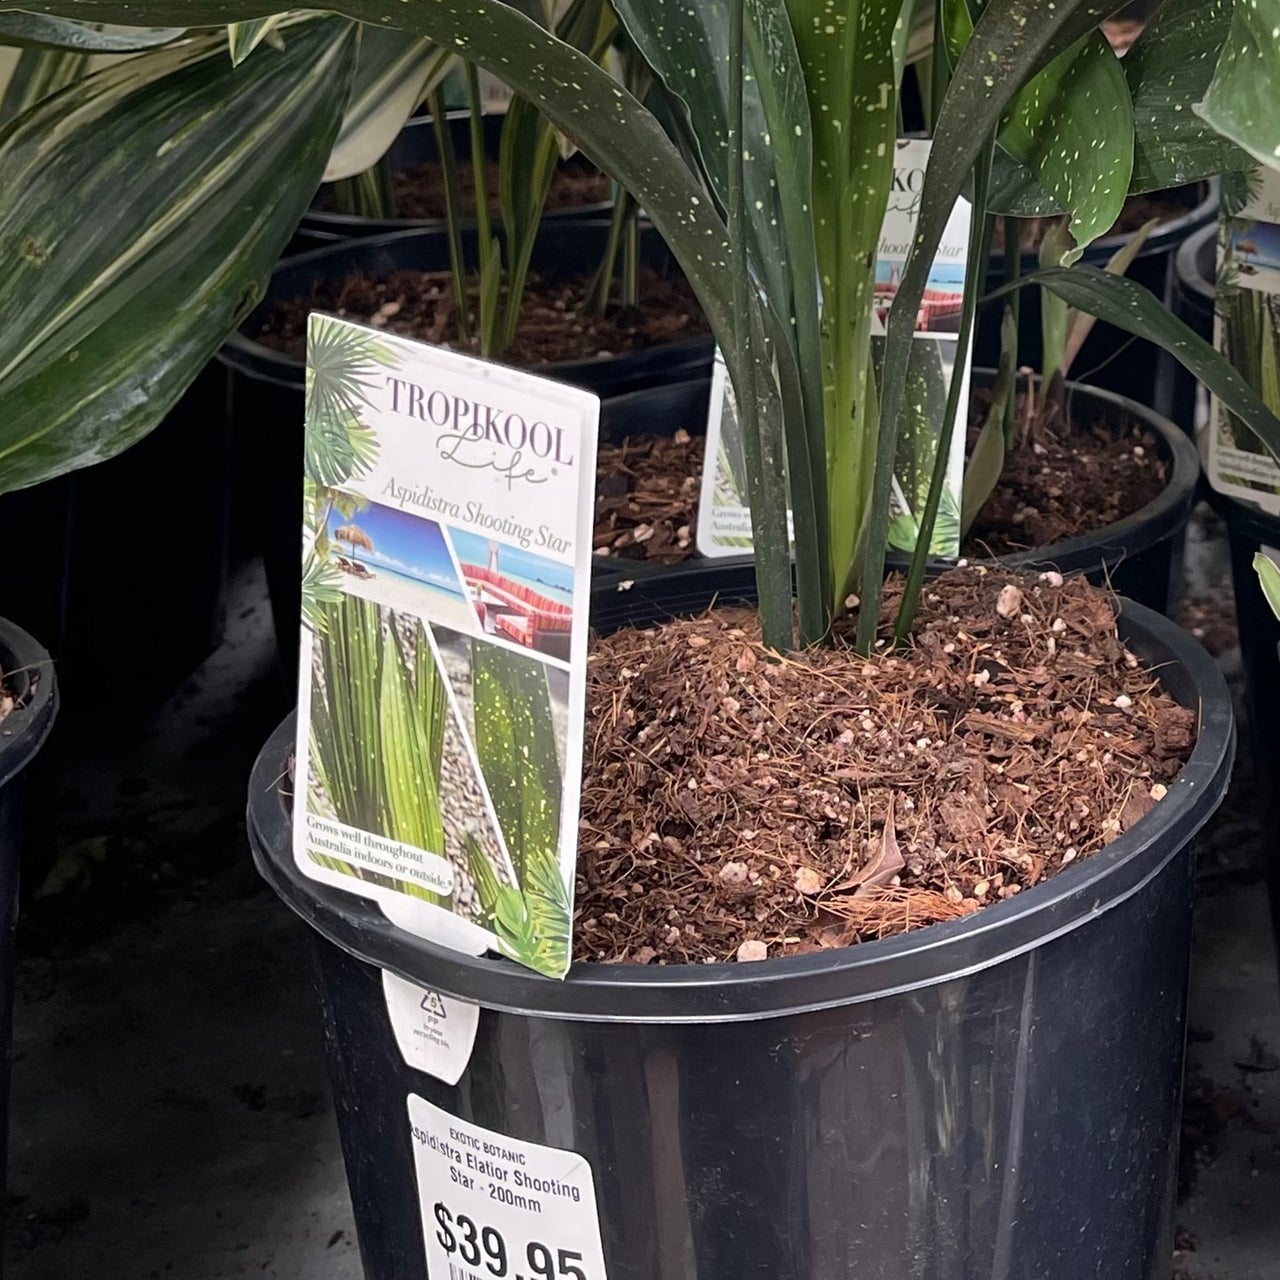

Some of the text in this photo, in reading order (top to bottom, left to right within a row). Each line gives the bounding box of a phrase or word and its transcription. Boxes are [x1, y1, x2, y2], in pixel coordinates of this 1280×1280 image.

[386, 376, 573, 466] TROPIKOOL
[436, 422, 549, 490] Life
[382, 477, 572, 554] Aspidistra Shooting Star
[306, 815, 424, 864] Grows well throughout
[306, 831, 352, 857] Australia
[353, 847, 394, 870] indoors
[394, 864, 408, 874] or
[427, 1015, 439, 1025] PP
[430, 997, 437, 1009] 5
[449, 1127, 526, 1166] EXOTIC BOTANIC
[450, 1165, 475, 1191] Star
[489, 1182, 542, 1213] 200mm
[466, 1153, 508, 1182] Elatior
[514, 1169, 581, 1202] Shooting
[434, 1201, 588, 1280] $39.95
